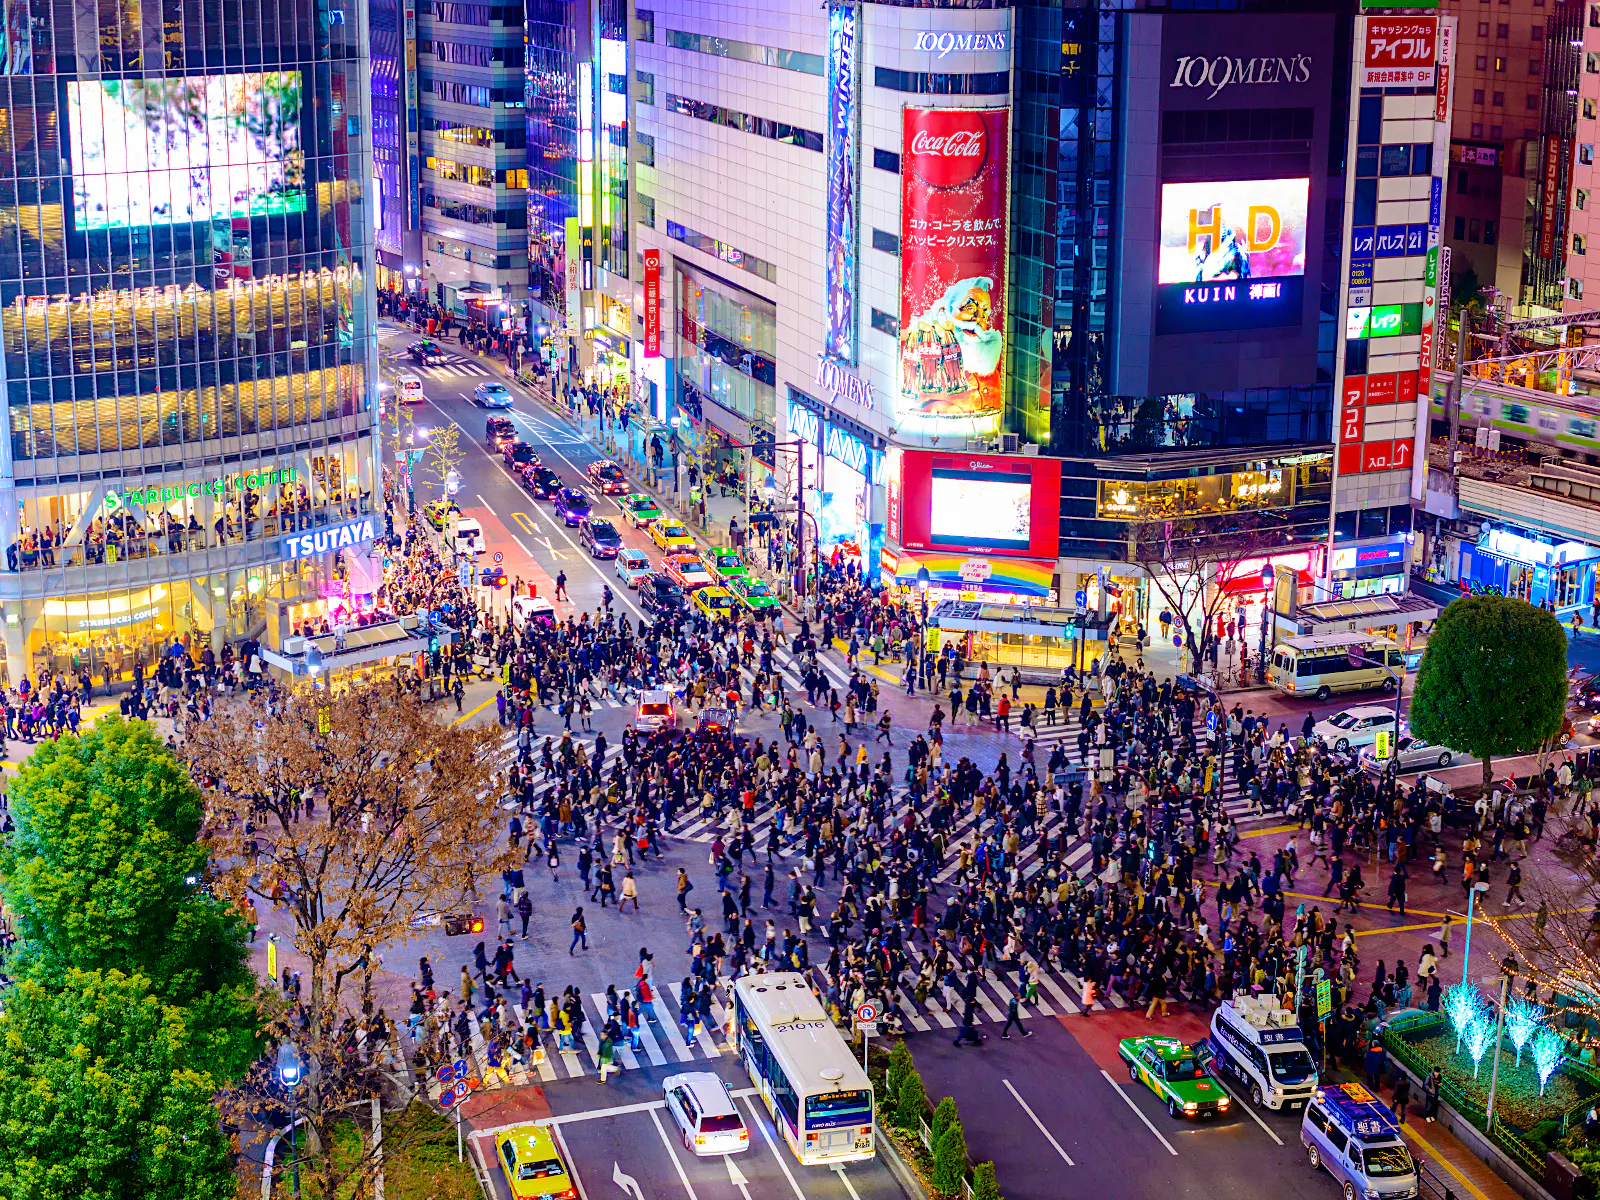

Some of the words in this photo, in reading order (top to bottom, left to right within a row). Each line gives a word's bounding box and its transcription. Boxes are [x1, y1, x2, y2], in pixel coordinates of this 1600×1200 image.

[1371, 25, 1431, 35] キャッシングなら
[1370, 38, 1431, 60] アイフル
[837, 16, 854, 129] WINTER
[1367, 71, 1414, 82] 新規会員募集中
[1417, 72, 1431, 81] 8F
[1438, 76, 1446, 116] アイフル
[911, 130, 984, 157] Coca-Cola
[909, 218, 1002, 232] コカ・コーラを飲んで、
[909, 234, 997, 247] ハッピークリスマス。
[1428, 255, 1436, 279] レイク
[1184, 285, 1236, 304] KUIN
[648, 281, 657, 351] 三菱東京UFJ銀行
[1371, 313, 1400, 329] レイク
[1422, 333, 1432, 368] アコム
[1345, 390, 1360, 439] アコム
[969, 460, 994, 470] Glico
[1368, 456, 1386, 468] 入口
[105, 480, 225, 508] STARBUCKS
[235, 467, 298, 492] COFFEE
[286, 520, 375, 558] TSUTAYA
[79, 616, 132, 628] STARBUCKS
[777, 1021, 825, 1033] 21016
